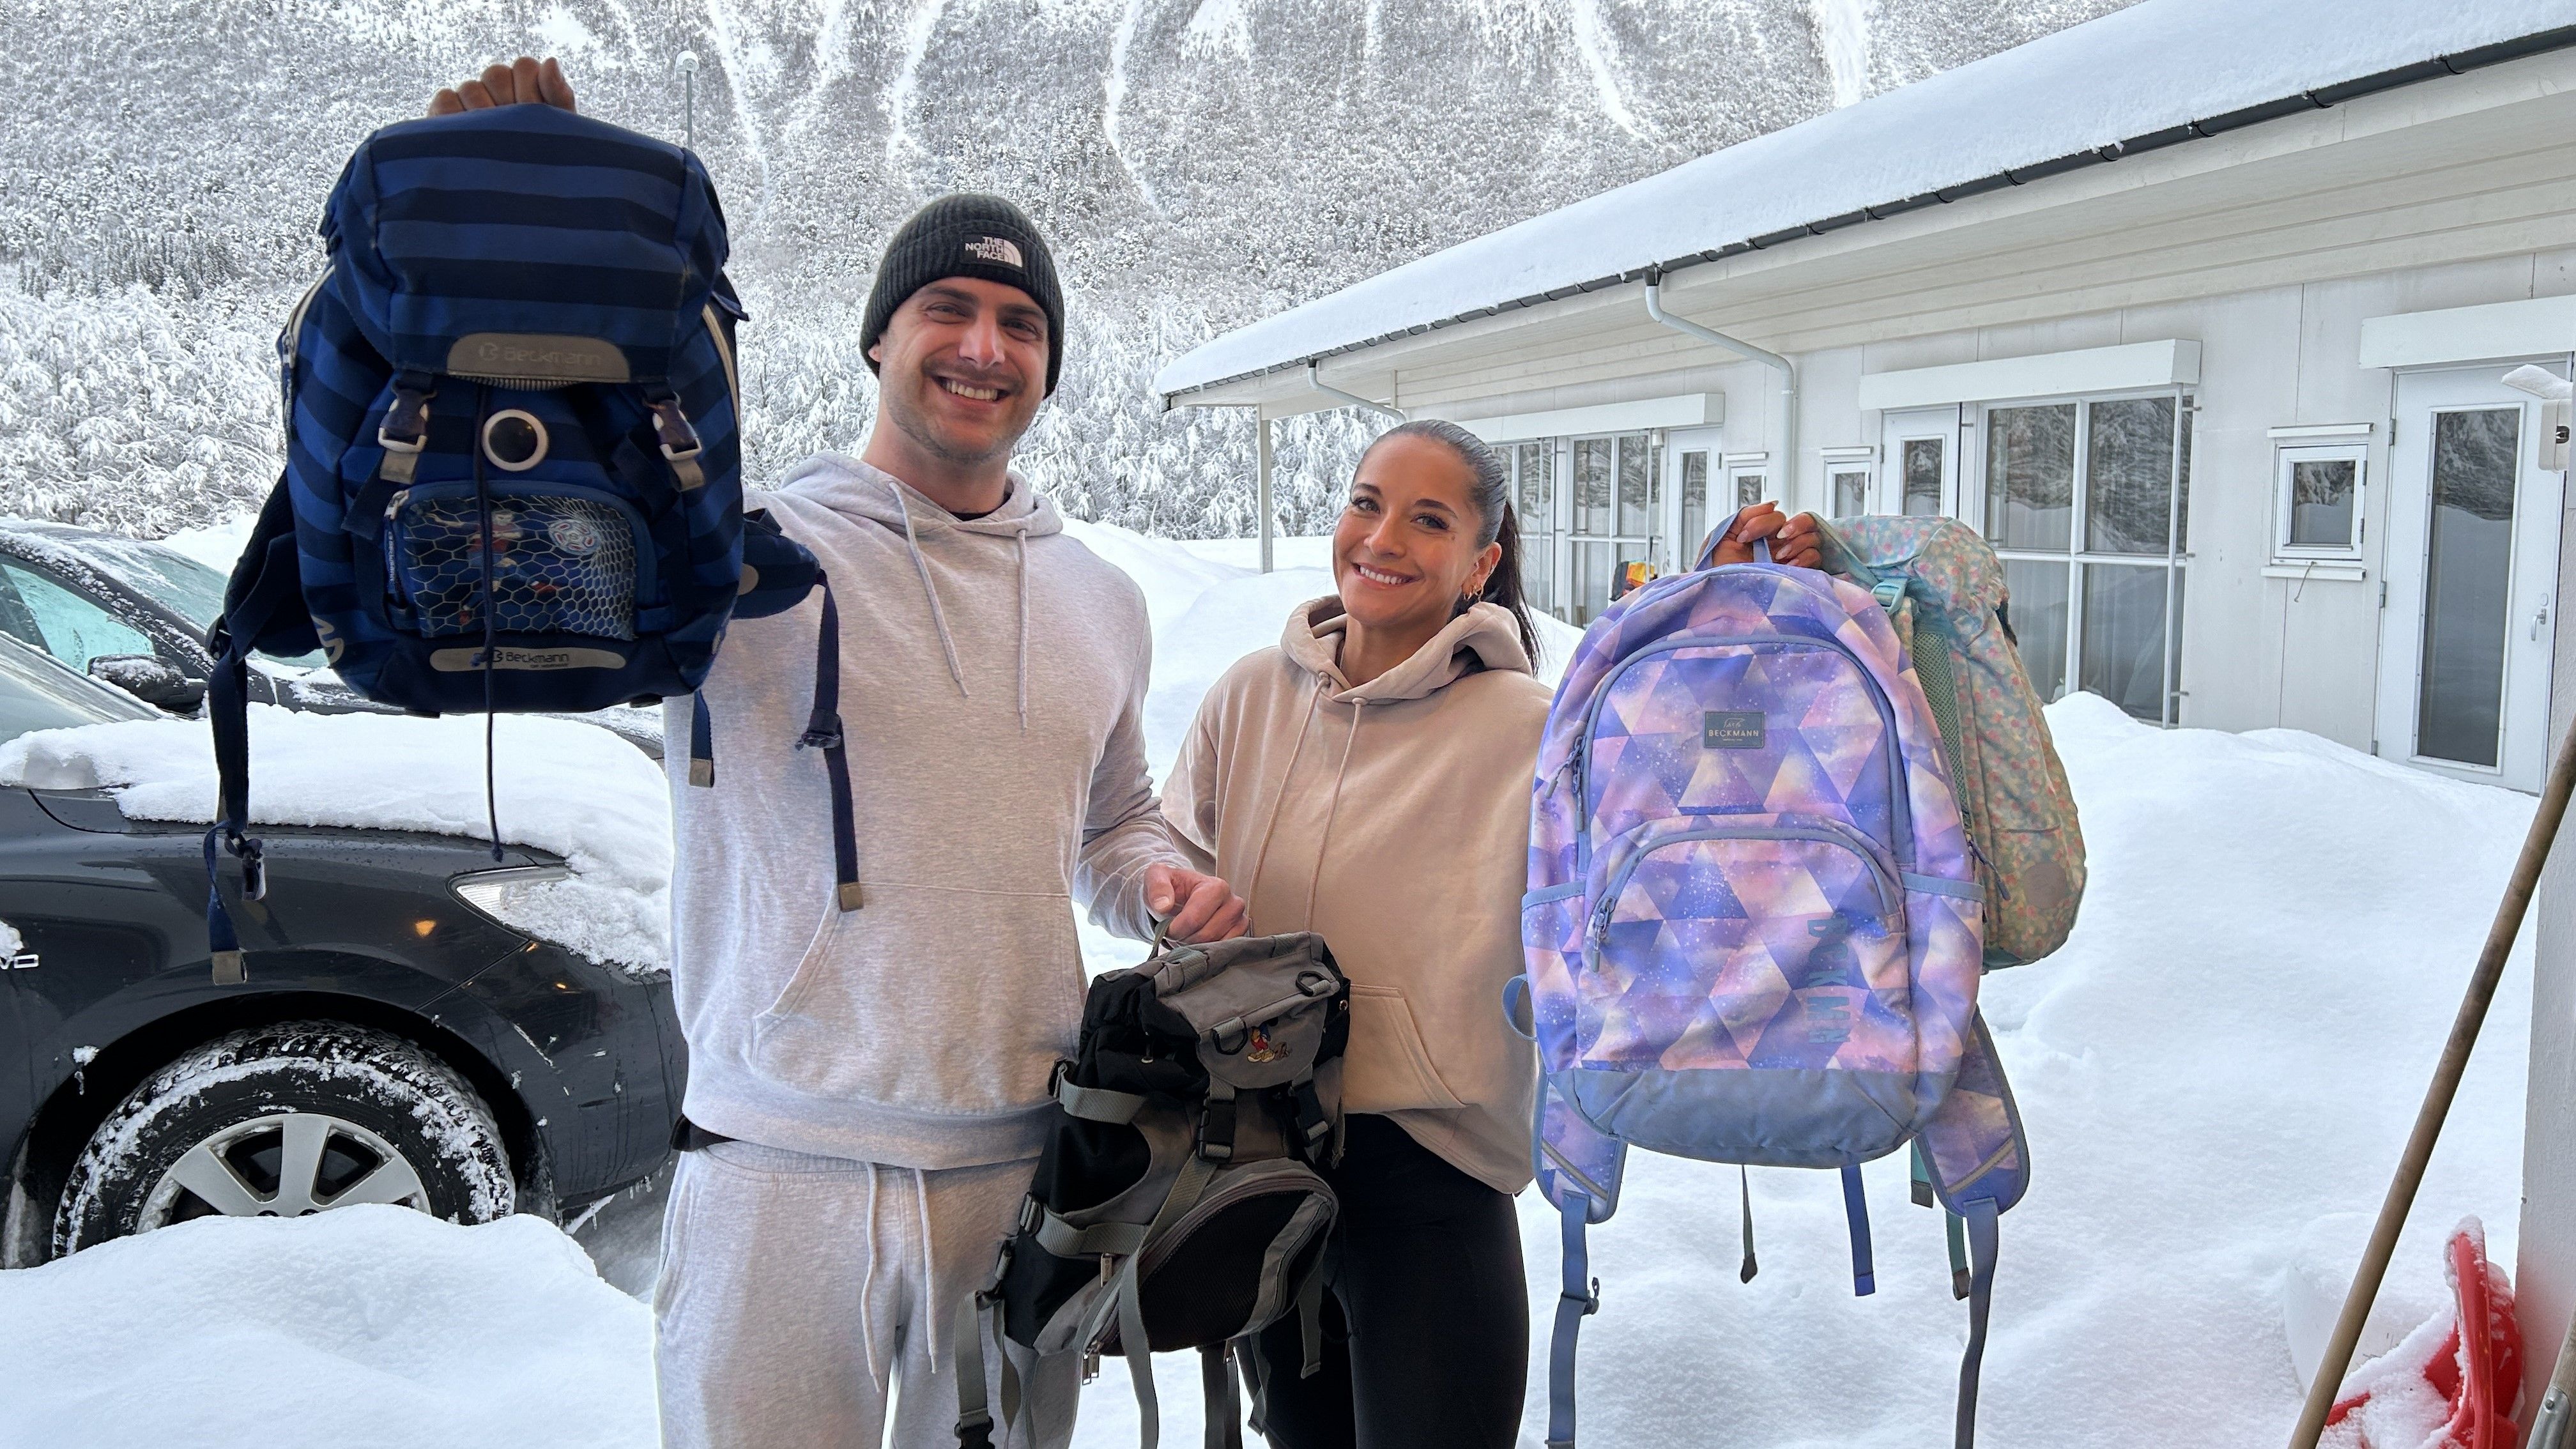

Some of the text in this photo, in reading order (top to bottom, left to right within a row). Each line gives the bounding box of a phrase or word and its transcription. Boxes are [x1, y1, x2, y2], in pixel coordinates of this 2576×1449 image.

[983, 236, 1004, 245] THE
[965, 243, 1004, 254] NORTH
[977, 250, 1004, 261] FACE
[503, 346, 603, 367] Beckmann
[505, 652, 569, 663] Beckmann
